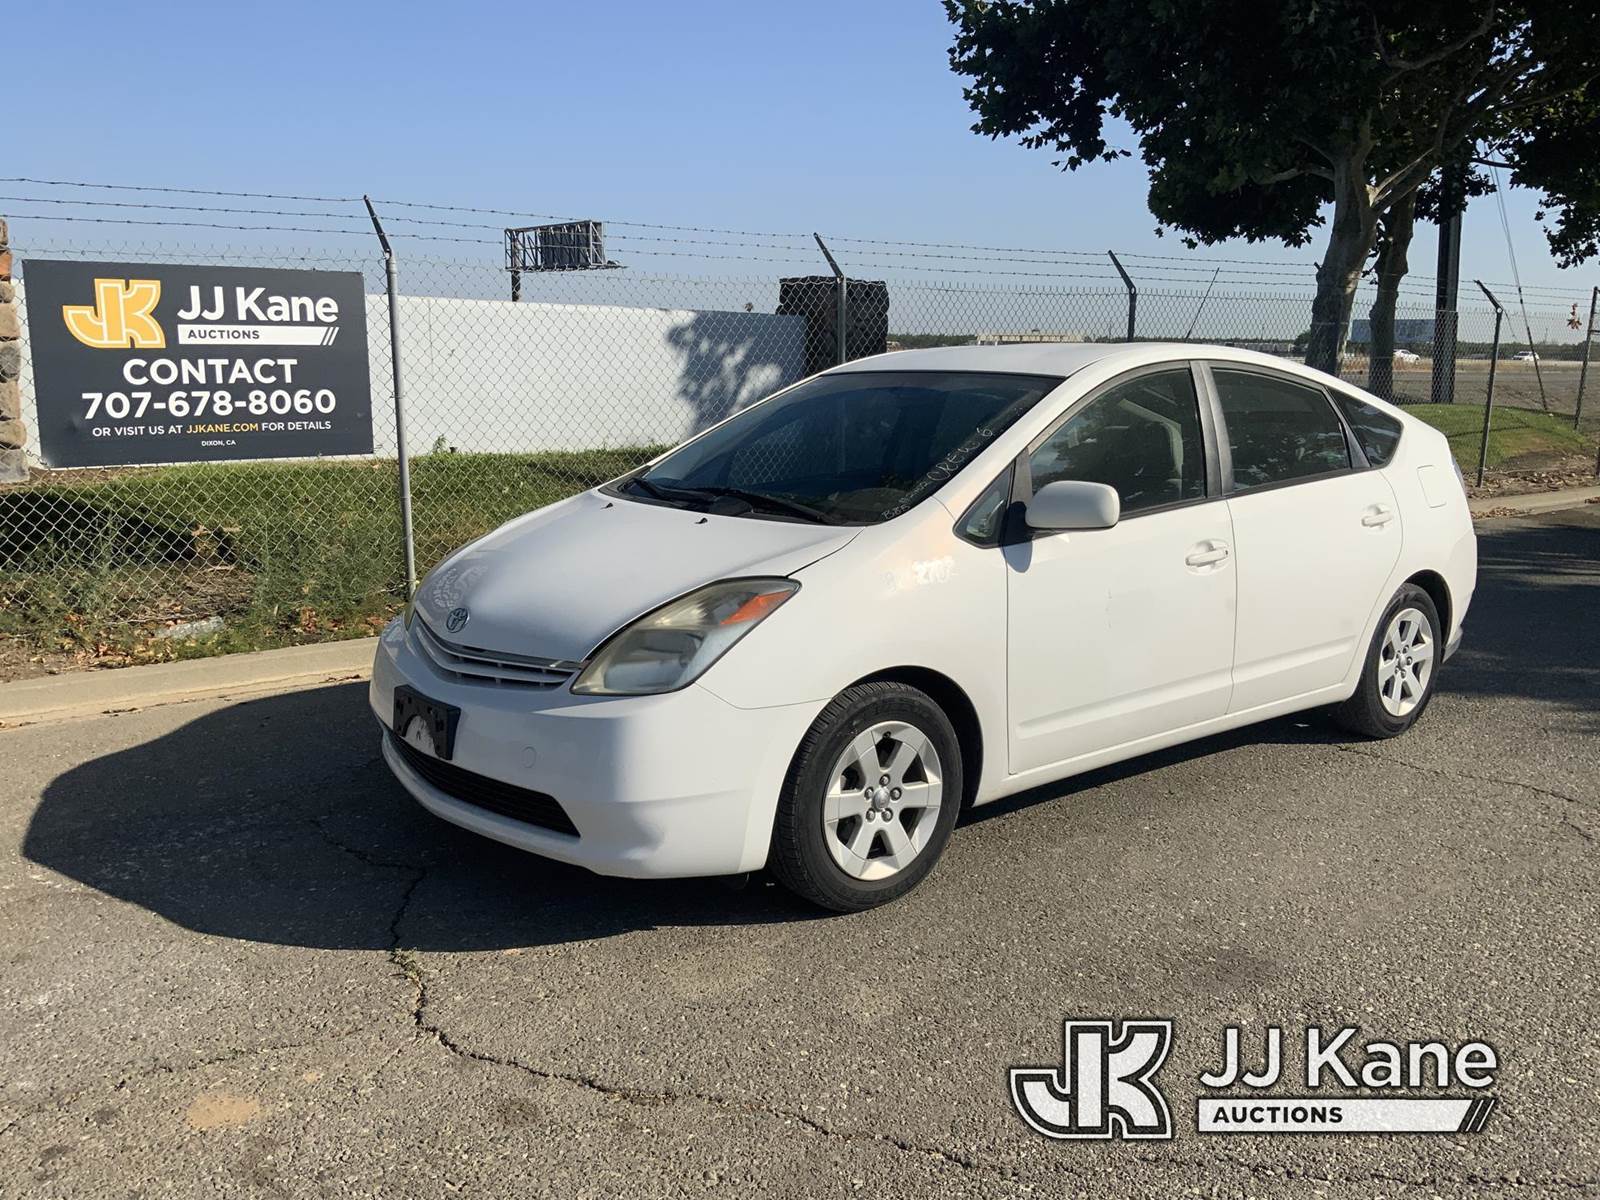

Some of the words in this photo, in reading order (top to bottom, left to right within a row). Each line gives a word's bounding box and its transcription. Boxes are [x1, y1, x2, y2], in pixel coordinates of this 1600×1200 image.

[62, 278, 166, 349] JK
[177, 285, 225, 321] JJ
[236, 287, 339, 323] Kane
[187, 329, 260, 341] AUCTIONS
[122, 358, 298, 386] CONTACT
[81, 388, 337, 420] 707-678-8060
[92, 427, 112, 437] OR
[114, 425, 146, 437] VISIT
[149, 425, 165, 435] US
[168, 424, 184, 435] AT
[186, 422, 259, 434] JJKANE.COM
[262, 421, 284, 432] FOR
[287, 420, 332, 431] DETAILS
[201, 439, 225, 447] DIXON,
[226, 438, 236, 446] CA
